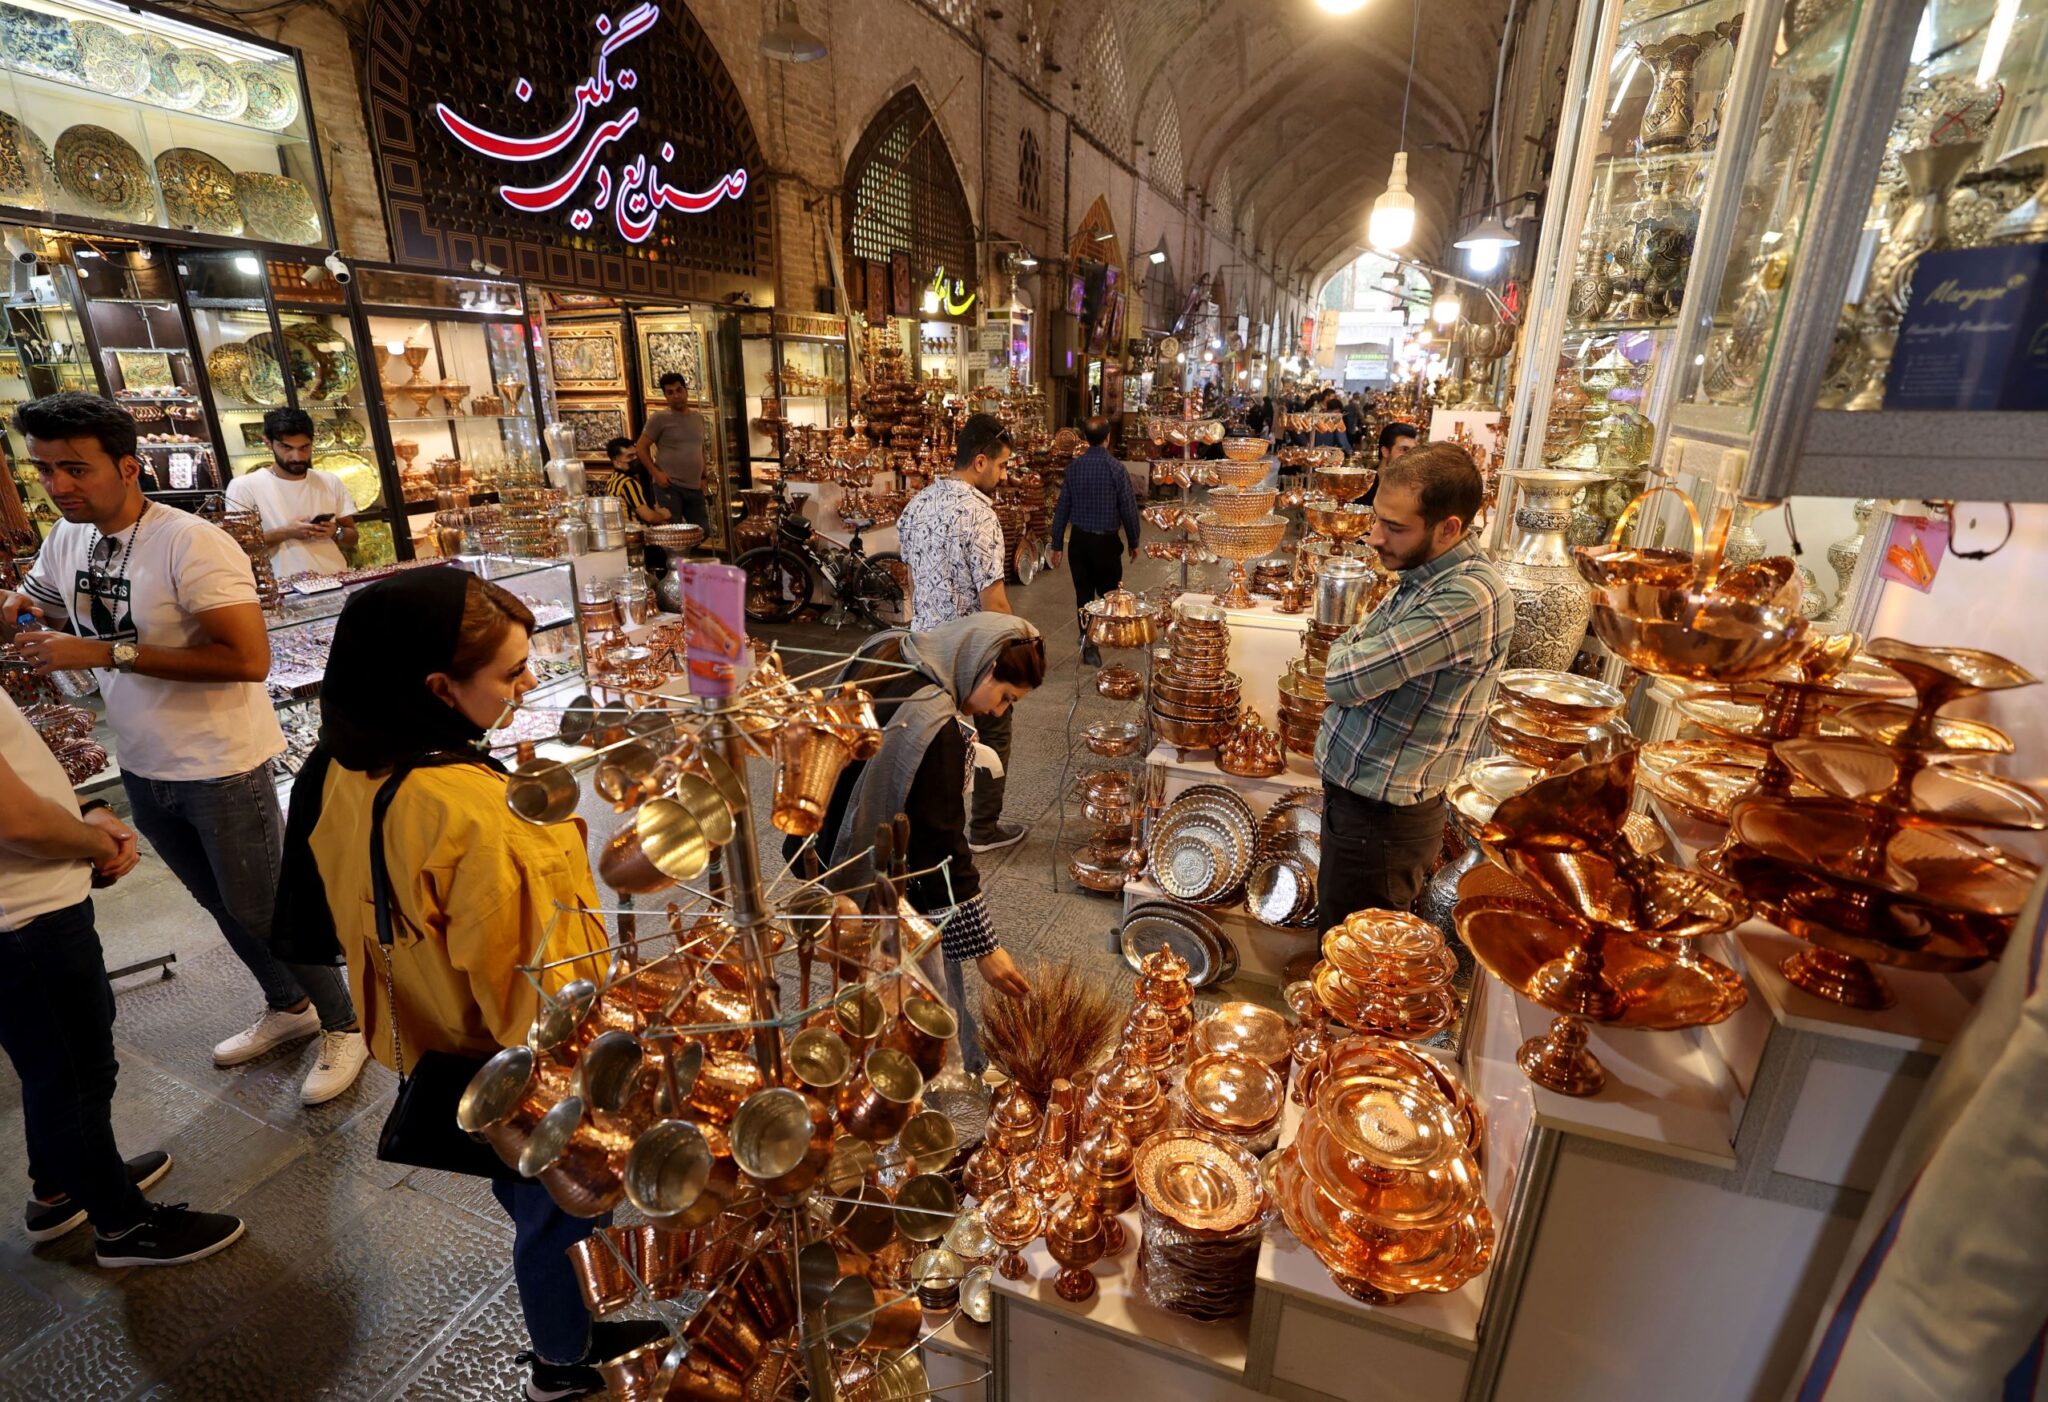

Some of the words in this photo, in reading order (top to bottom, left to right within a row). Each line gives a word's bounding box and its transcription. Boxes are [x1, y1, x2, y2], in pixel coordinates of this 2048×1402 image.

[436, 2, 660, 162] نگین
[500, 68, 640, 230] دستی
[616, 141, 748, 243] صنایع
